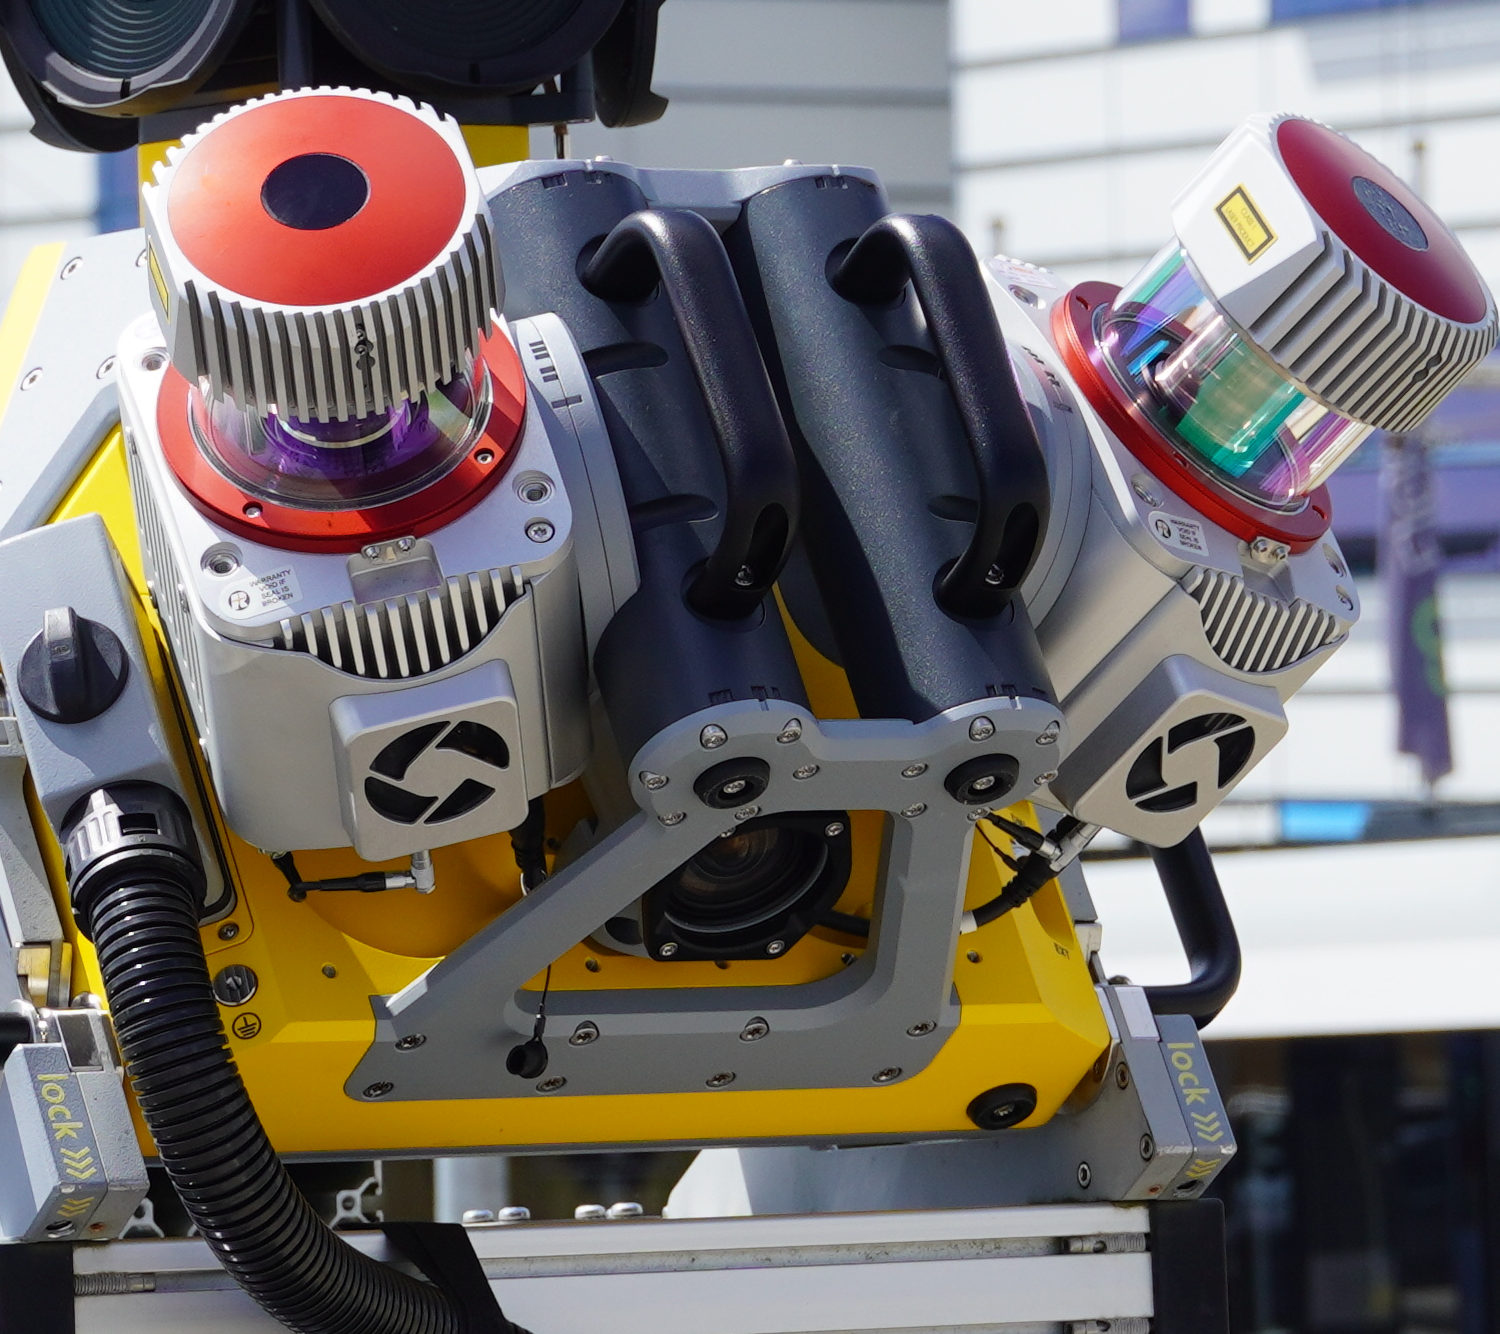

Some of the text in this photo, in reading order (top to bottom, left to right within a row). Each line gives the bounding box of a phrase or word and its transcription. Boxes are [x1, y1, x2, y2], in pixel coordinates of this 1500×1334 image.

[249, 569, 292, 587] WARRANTY
[261, 593, 294, 607] BROKEN
[1166, 1042, 1211, 1106] lock
[36, 1073, 84, 1141] lock
